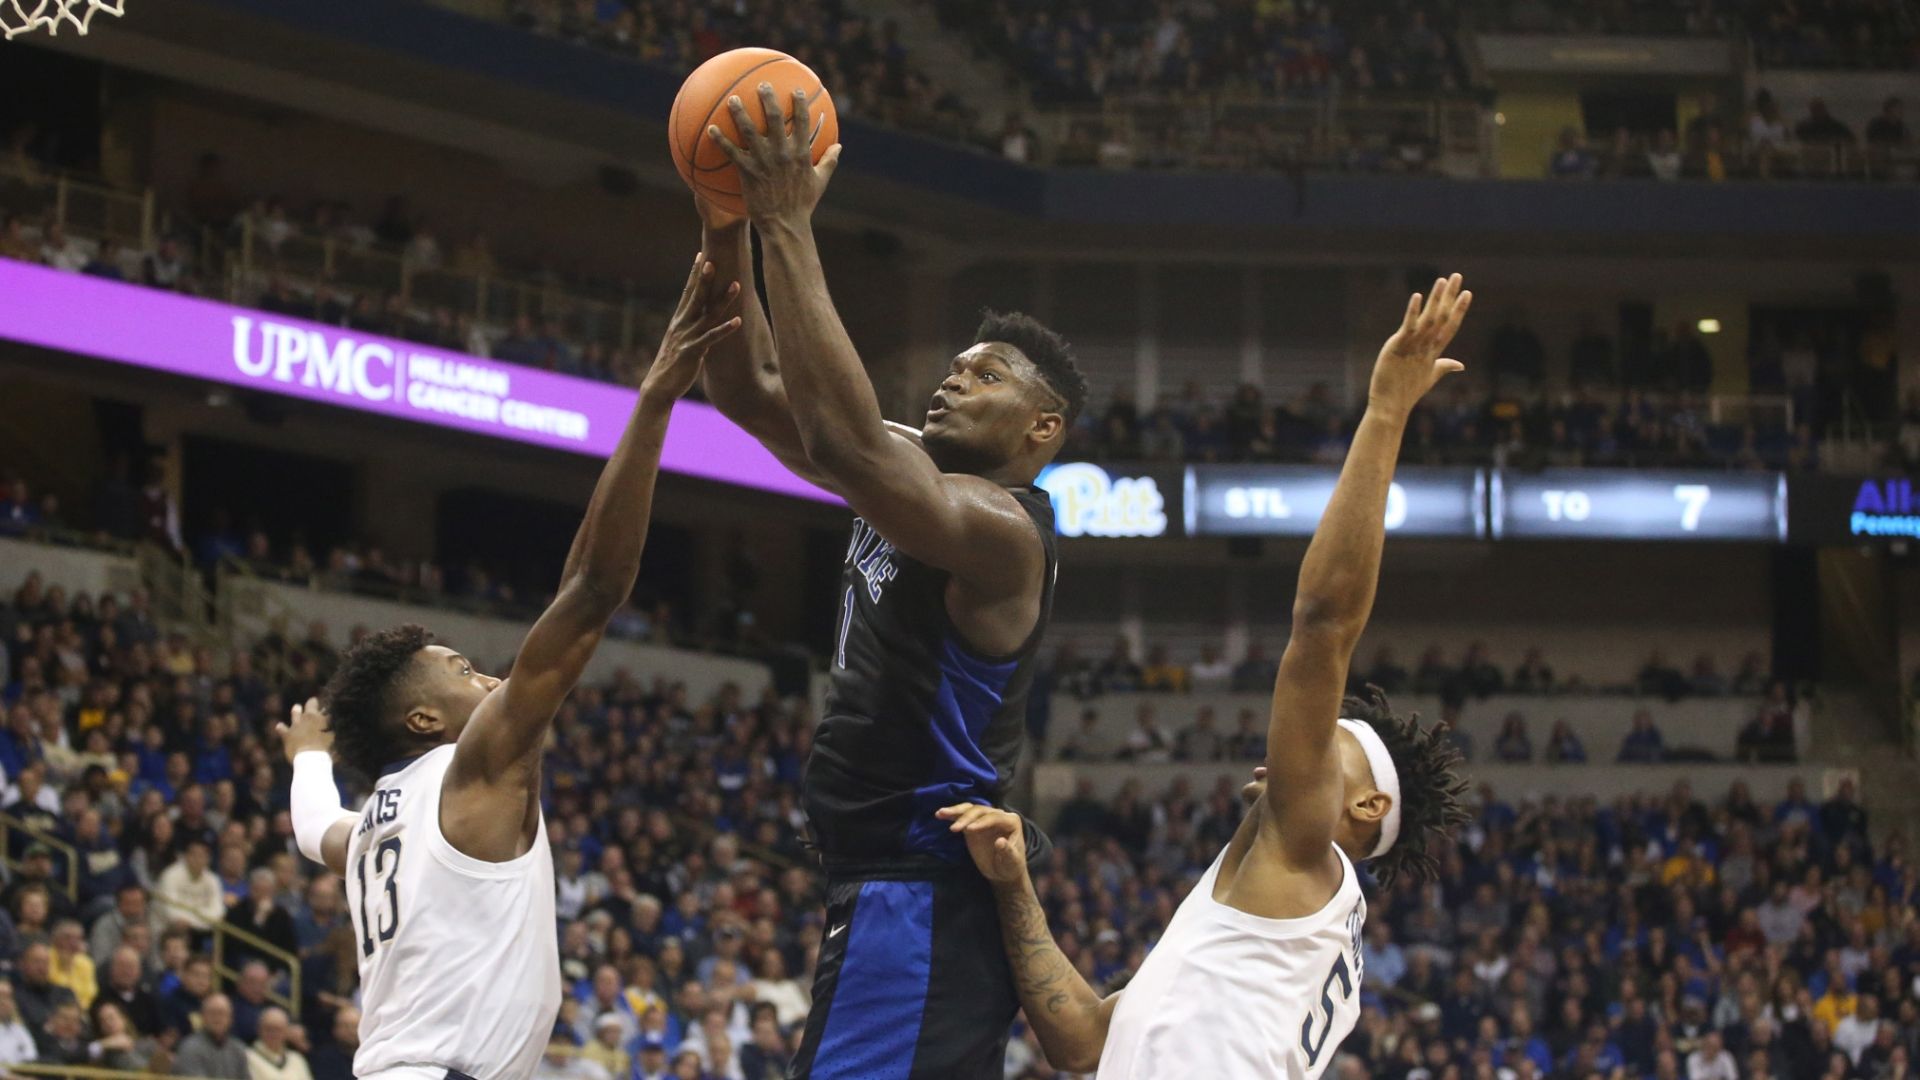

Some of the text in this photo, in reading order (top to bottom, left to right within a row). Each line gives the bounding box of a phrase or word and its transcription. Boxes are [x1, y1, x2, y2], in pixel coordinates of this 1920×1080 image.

[232, 315, 394, 401] UPMC
[408, 352, 511, 398] HILLMAN
[407, 380, 589, 442] CANCER CENTER
[1050, 463, 1167, 537] Pitt
[1225, 487, 1291, 519] STL
[1541, 484, 1711, 531] TO 7
[1854, 479, 1920, 513] All
[838, 584, 855, 669] 1
[358, 834, 402, 958] 13
[1301, 951, 1353, 1068] 5
